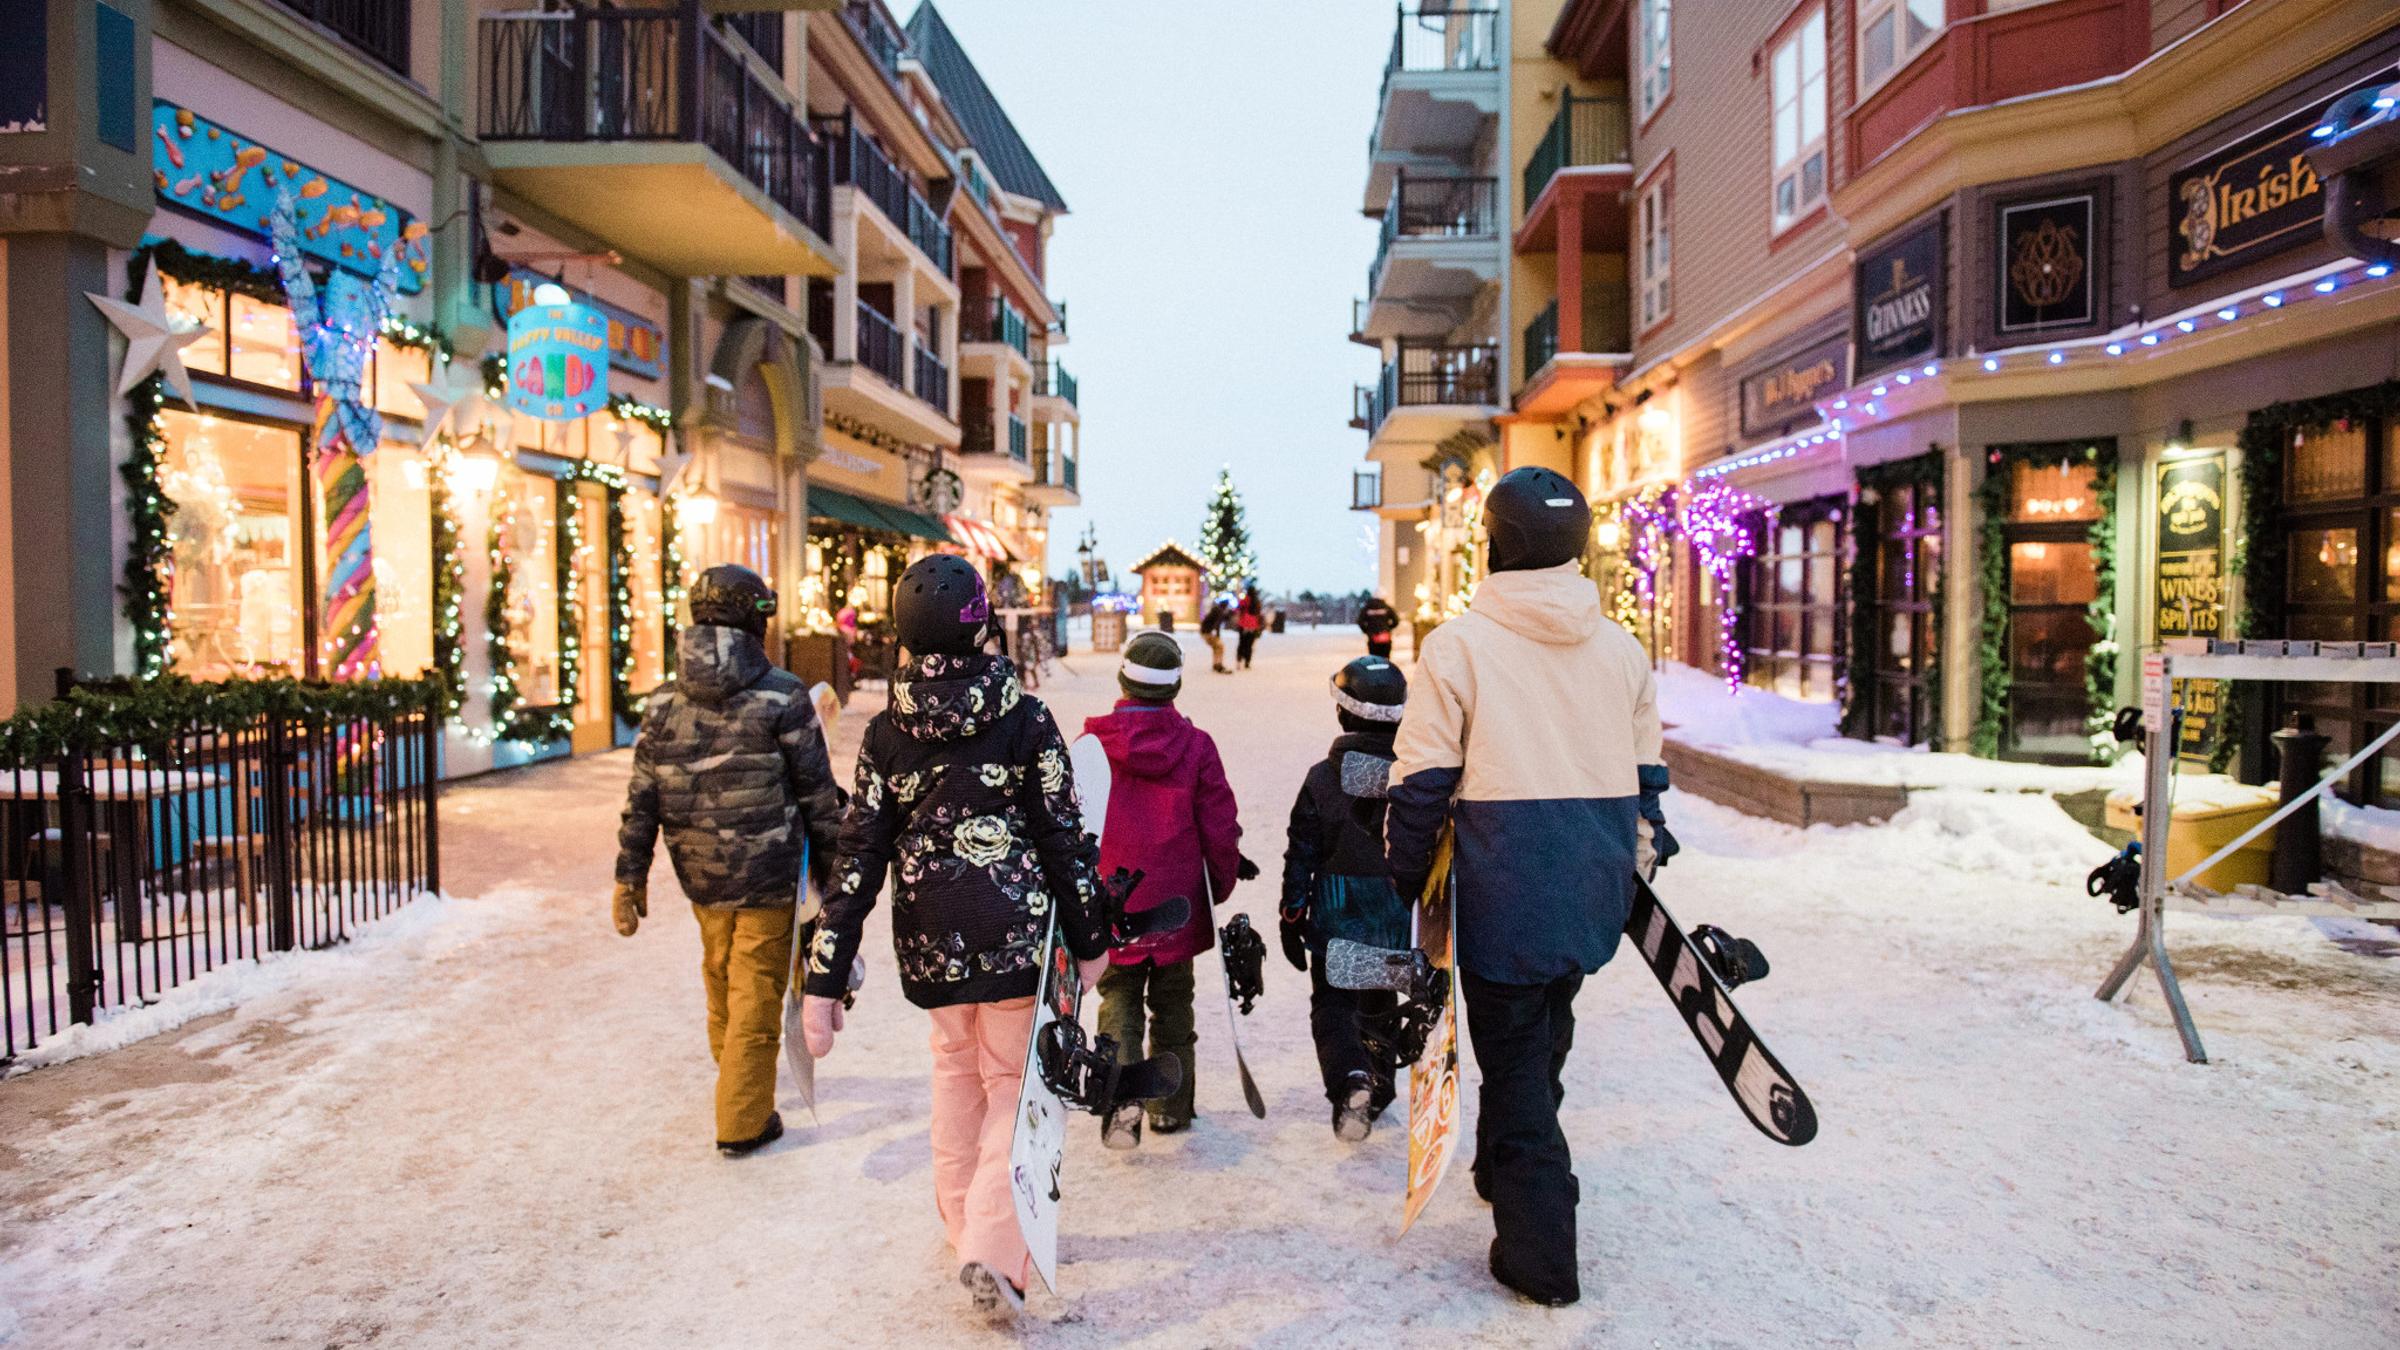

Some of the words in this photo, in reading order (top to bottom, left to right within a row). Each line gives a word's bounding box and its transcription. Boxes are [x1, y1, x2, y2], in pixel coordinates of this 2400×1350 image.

[1866, 284, 1931, 342] GUINNESS
[514, 354, 596, 400] CANDY
[2160, 577, 2218, 603] WINES
